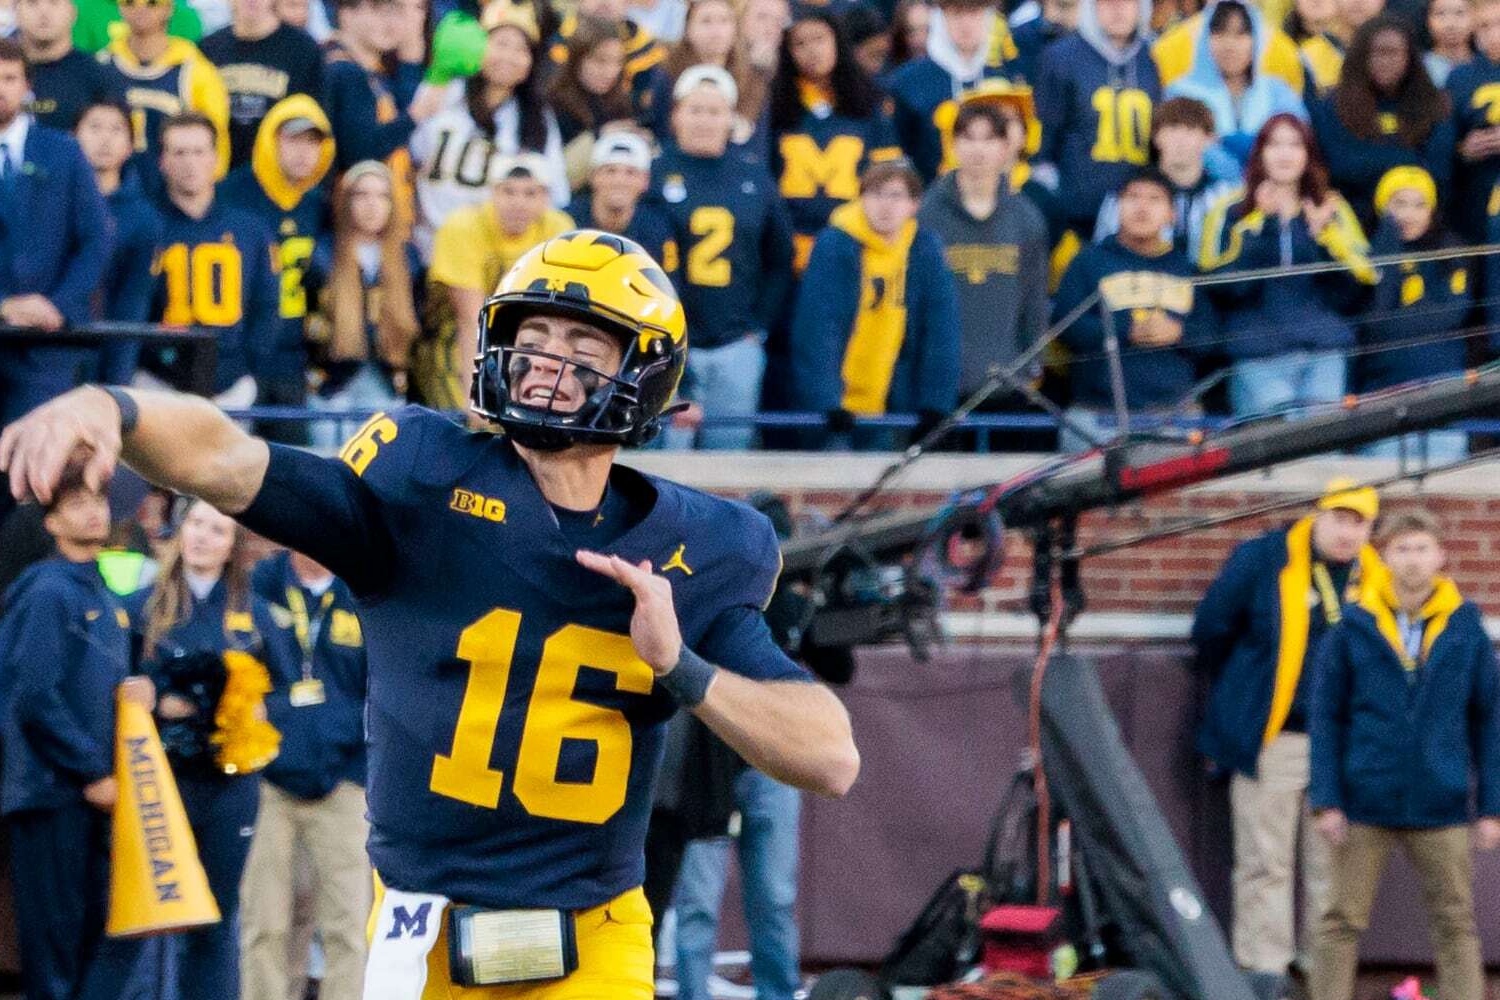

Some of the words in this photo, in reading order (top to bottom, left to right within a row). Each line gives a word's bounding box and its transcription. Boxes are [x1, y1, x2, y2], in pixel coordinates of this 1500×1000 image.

[429, 130, 495, 188] 10
[1091, 86, 1152, 164] 10
[779, 133, 864, 199] M
[161, 242, 243, 327] 10
[688, 206, 735, 287] 2
[339, 411, 398, 478] 6
[430, 607, 655, 826] 16
[128, 735, 181, 902] MICHIGAN
[387, 903, 432, 939] M
